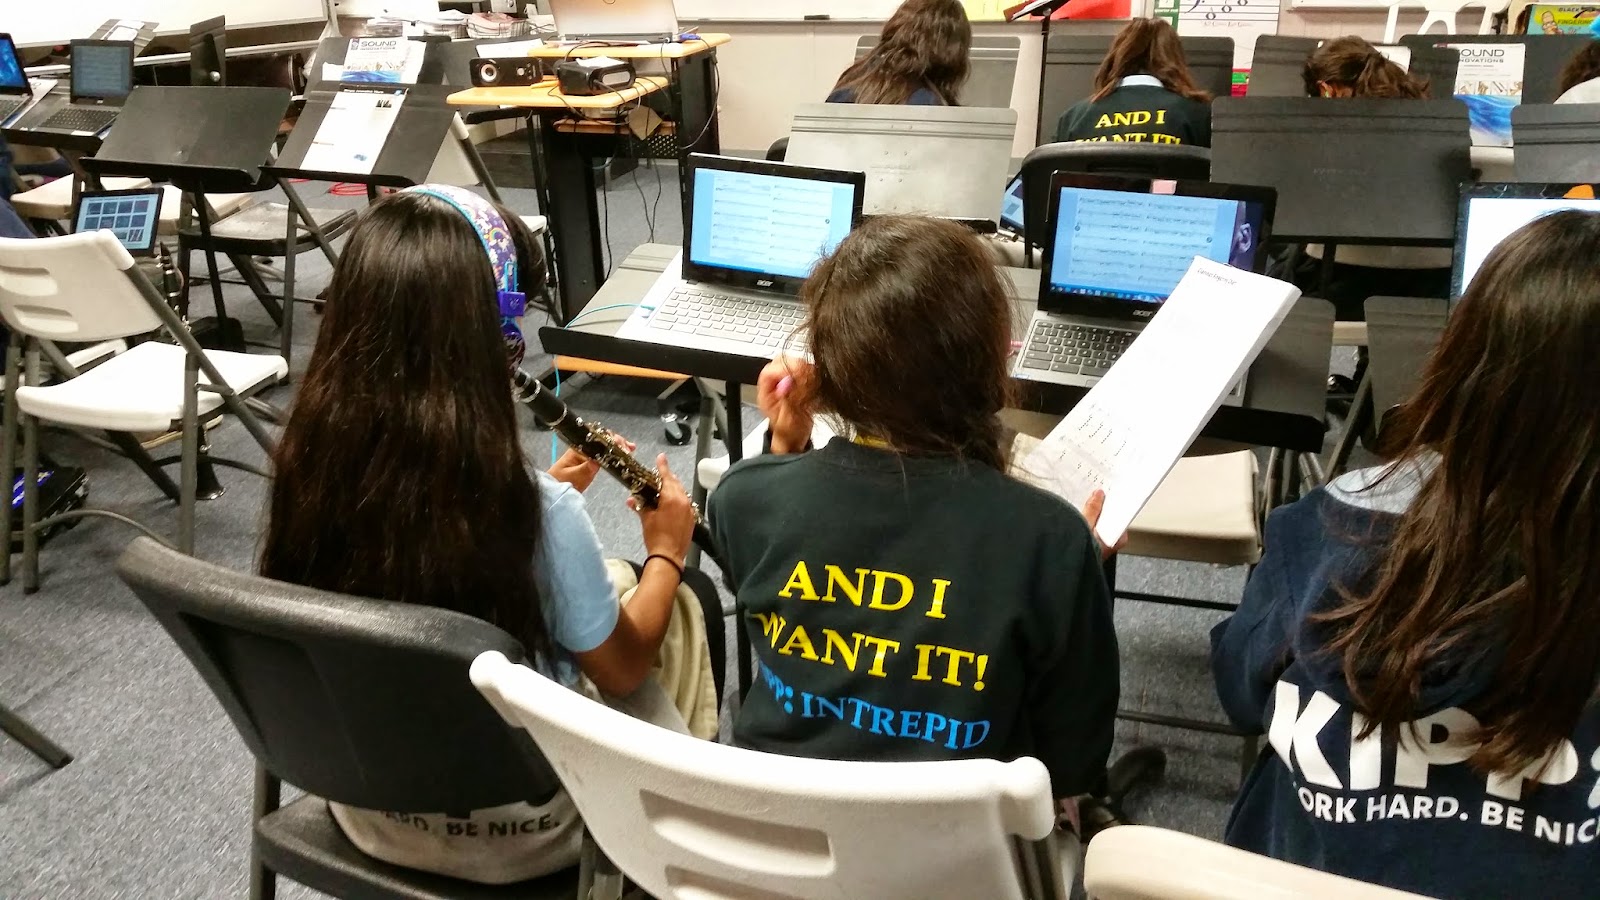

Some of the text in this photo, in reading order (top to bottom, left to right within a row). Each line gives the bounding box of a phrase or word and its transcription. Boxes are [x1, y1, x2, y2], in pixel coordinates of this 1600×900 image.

[1460, 48, 1505, 57] OUND
[1095, 109, 1167, 129] AND I
[1075, 132, 1147, 144] NT
[778, 560, 951, 619] AND I
[753, 612, 989, 692] WANT IT!
[760, 660, 991, 750] PP: INTREPID
[446, 821, 478, 836] BE
[488, 813, 561, 837] NICE.
[1295, 784, 1357, 823] ORK
[1366, 794, 1469, 822] HARD.
[1481, 800, 1524, 832] BE
